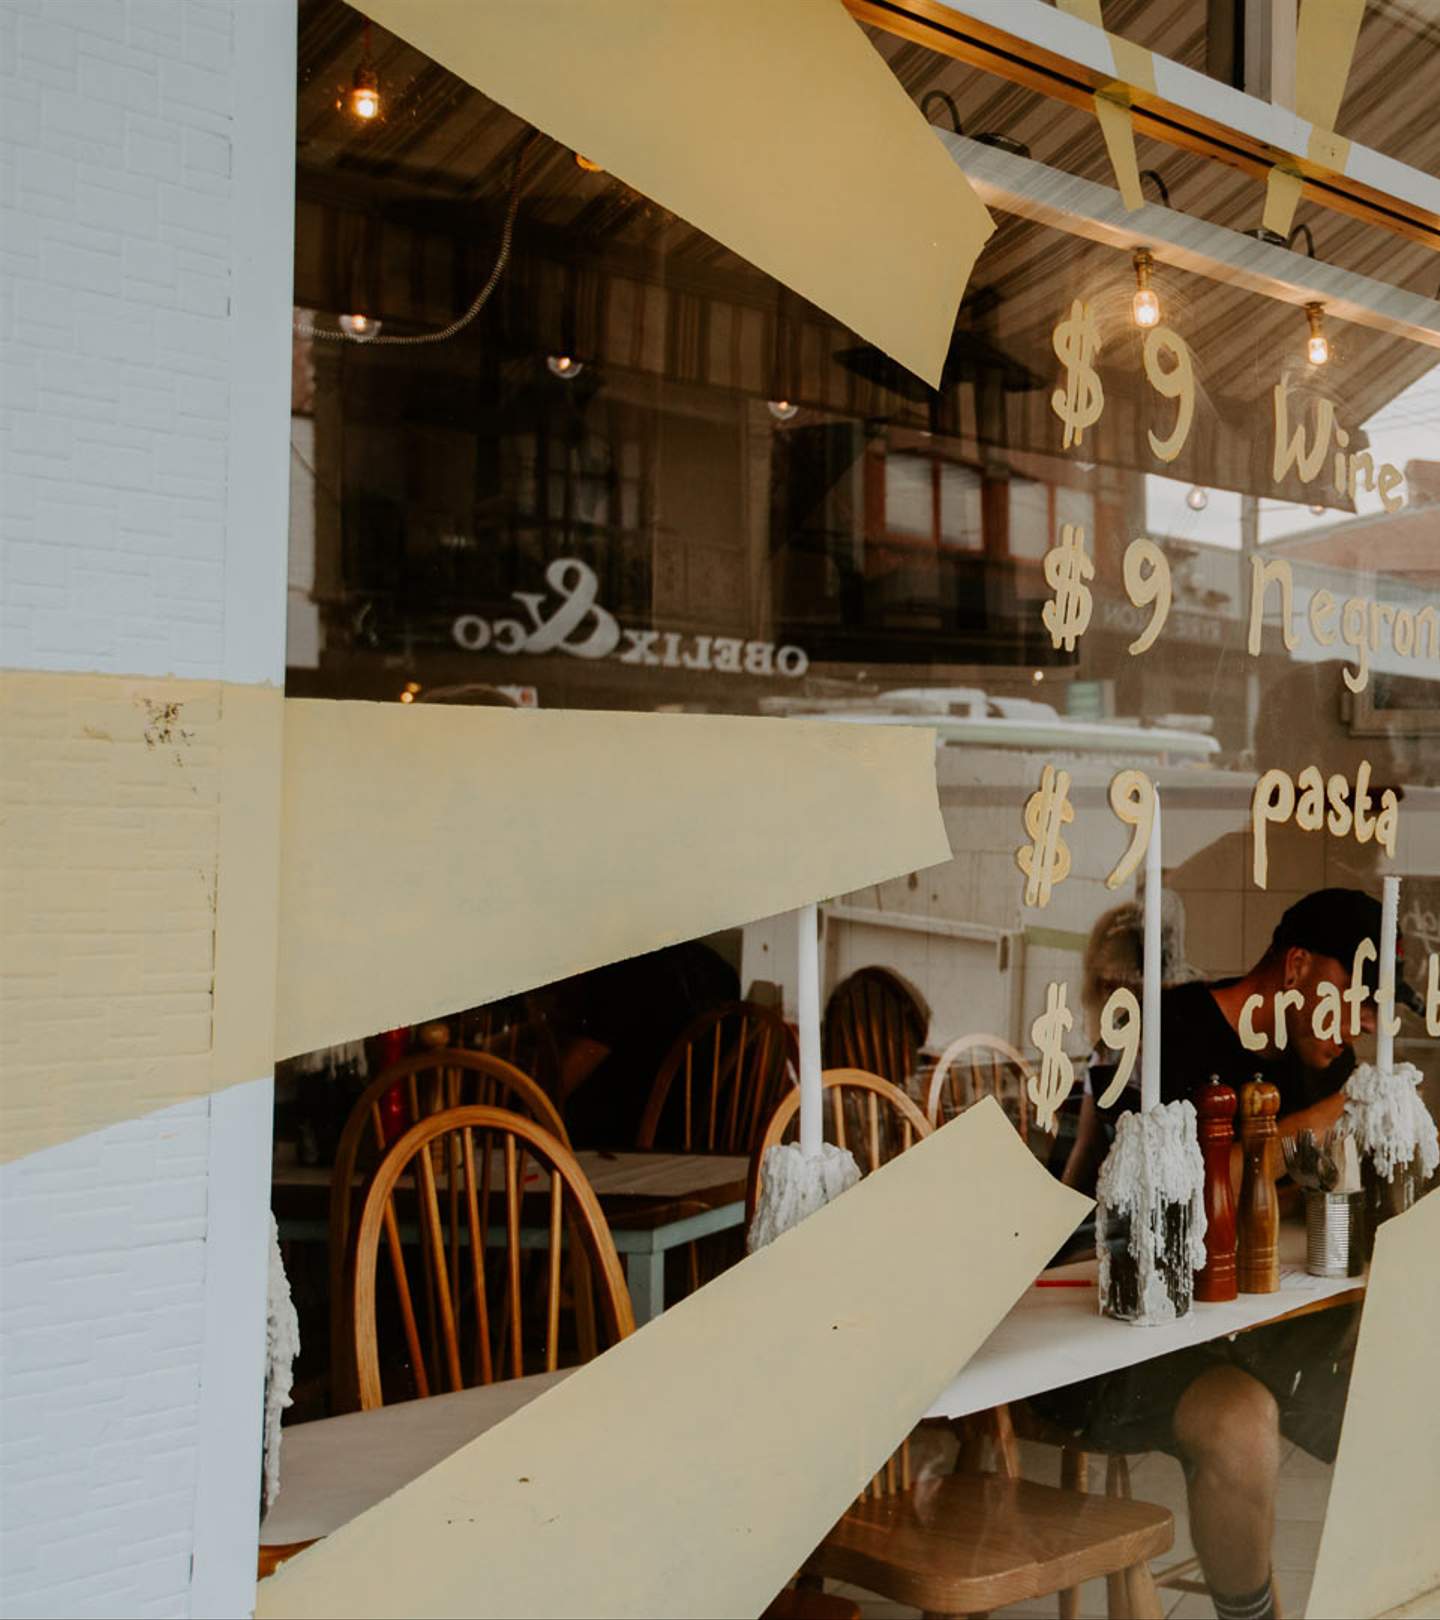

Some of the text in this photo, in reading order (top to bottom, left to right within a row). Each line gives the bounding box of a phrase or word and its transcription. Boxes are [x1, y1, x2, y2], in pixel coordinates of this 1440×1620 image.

[1273, 384, 1406, 513] Wine
[1252, 759, 1399, 890] pasta
[1238, 937, 1402, 1051] craft
